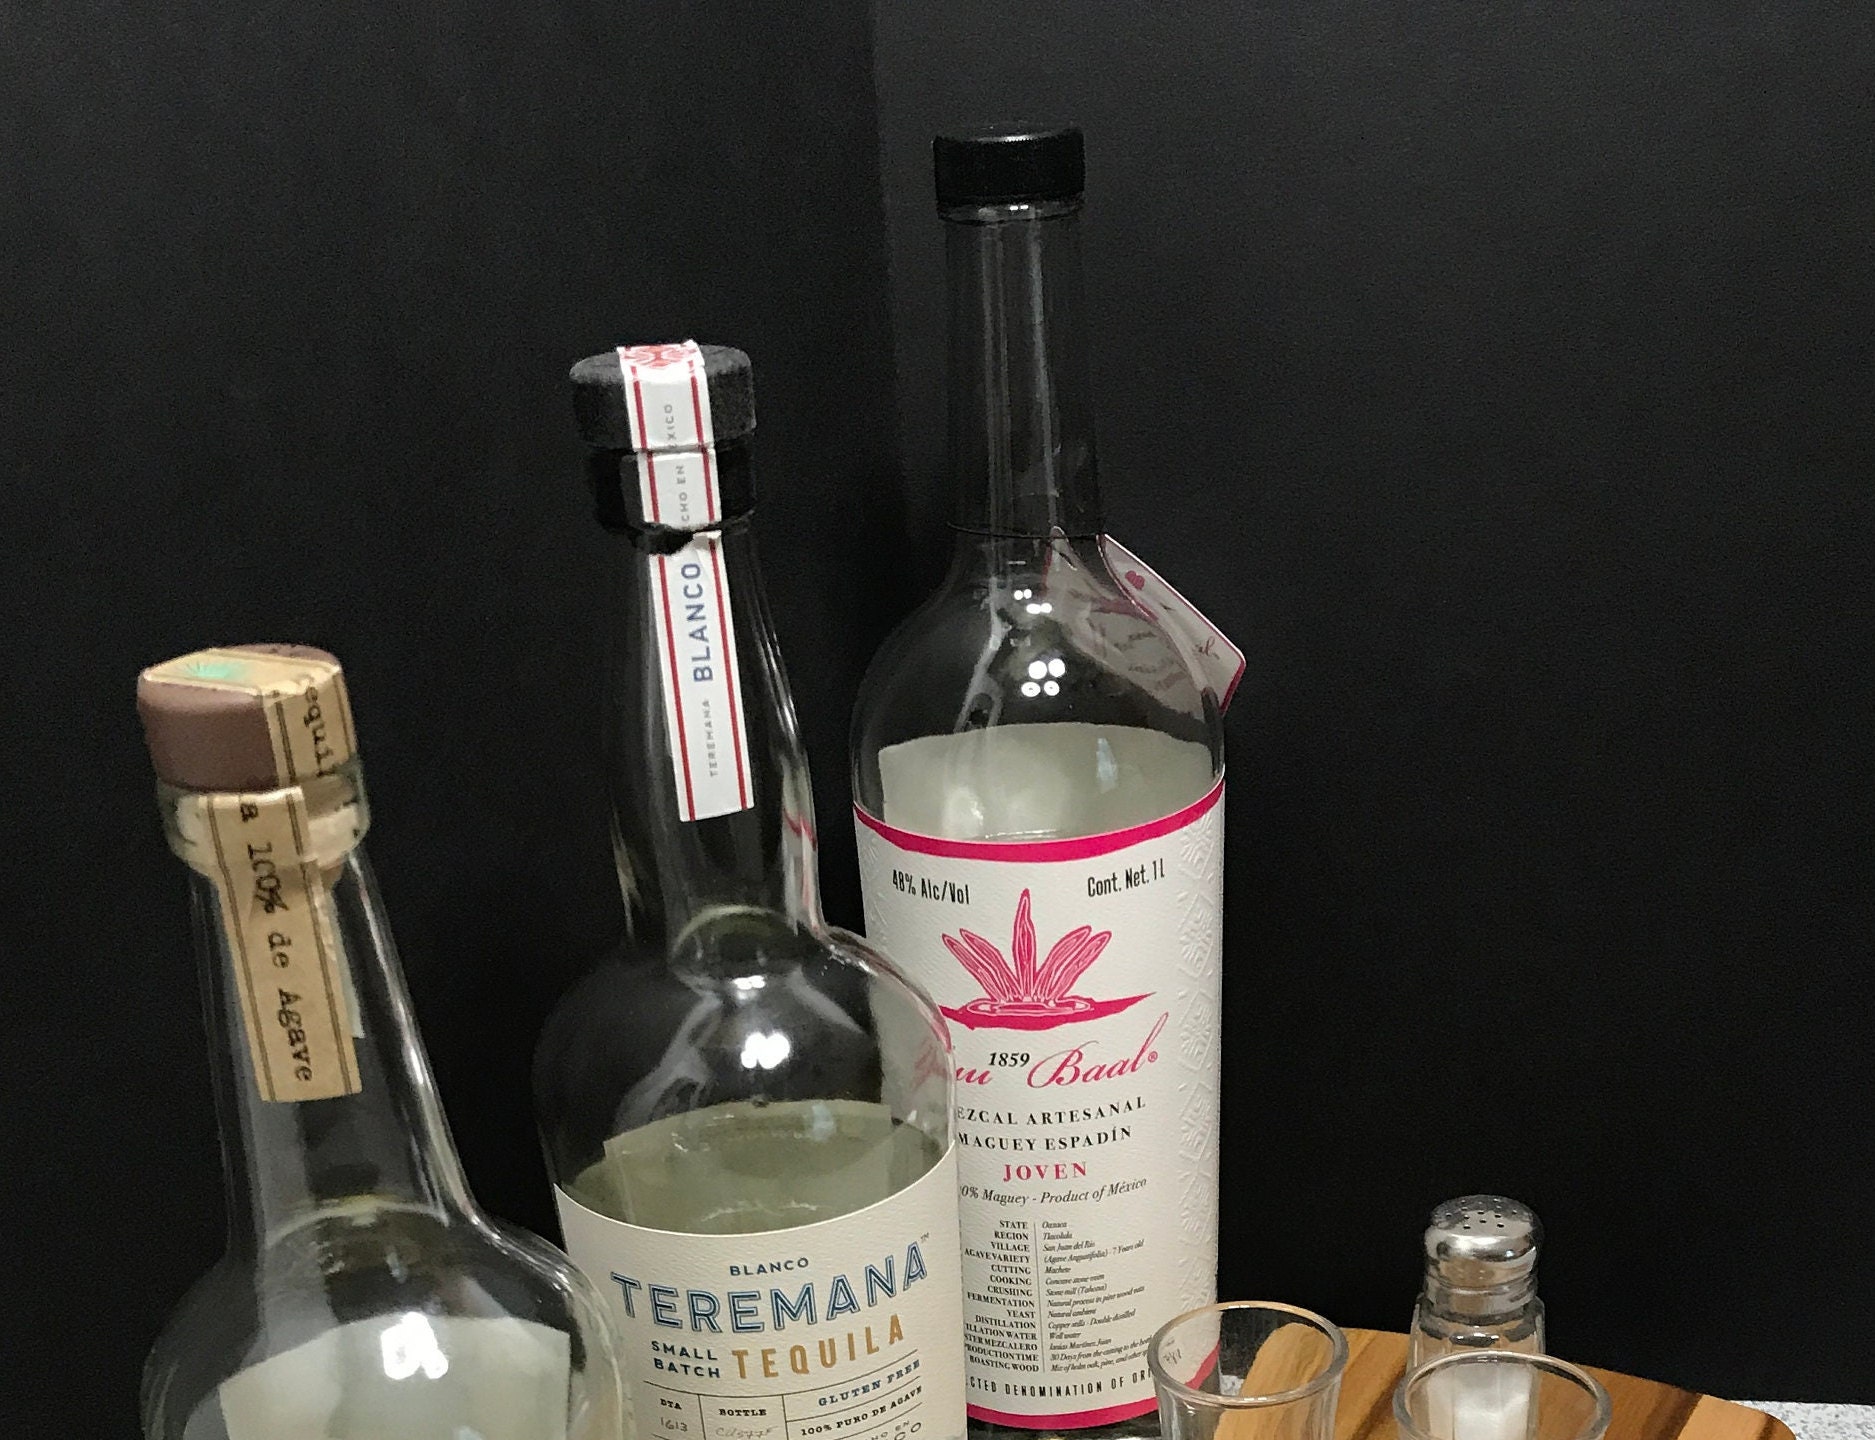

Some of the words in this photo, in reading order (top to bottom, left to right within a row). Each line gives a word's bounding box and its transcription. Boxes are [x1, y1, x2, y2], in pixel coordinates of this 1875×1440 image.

[675, 465, 686, 484] EN
[681, 563, 714, 683] BLANCO
[702, 700, 718, 778] TEREMANA
[246, 841, 289, 914] 100%
[892, 869, 917, 896] 48%
[921, 878, 970, 905] Alc/Vol
[1087, 872, 1122, 897] Cont.
[1125, 864, 1150, 889] Net.
[267, 931, 290, 970] de
[277, 988, 313, 1082] Agave
[988, 1052, 1031, 1068] 1859
[1026, 1012, 1169, 1089] Baal
[1026, 1096, 1146, 1126] ARTESANAL
[958, 1131, 1036, 1151] MAGUEY
[1045, 1126, 1132, 1151] ESPADÍN
[1003, 1161, 1087, 1183] JOVEN
[982, 1188, 1029, 1207] Maguey
[1040, 1189, 1090, 1204] Product
[1091, 1184, 1108, 1203] of
[1106, 1178, 1147, 1197] México
[994, 1230, 1029, 1241] REGION
[1000, 1220, 1028, 1230] STATE
[964, 1248, 992, 1260] AGAVE
[992, 1252, 1031, 1263] VARIETY
[1134, 1238, 1145, 1248] old
[990, 1241, 1030, 1253] VILLAGE
[1042, 1243, 1055, 1252] San
[1073, 1241, 1084, 1251] del
[730, 1257, 810, 1277] BLANCO
[991, 1264, 1032, 1275] CUTTING
[610, 1241, 928, 1334] TEREMANA
[987, 1285, 1033, 1297] CRUSHING
[1064, 1286, 1078, 1295] mill
[989, 1274, 1032, 1286] COOKING
[967, 1291, 1035, 1308] FERMENTATION
[1047, 1298, 1073, 1308] Natural
[975, 1314, 1036, 1329] DISTILLATION
[1048, 1321, 1071, 1331] Copper
[1006, 1309, 1036, 1319] YEAST
[1048, 1309, 1073, 1318] Natural
[731, 1314, 905, 1380] TEQUILA
[984, 1337, 1038, 1351] MEZCALERO
[1005, 1331, 1037, 1341] WATER
[651, 1340, 718, 1361] SMALL
[1015, 1352, 1039, 1362] TIME
[1077, 1351, 1092, 1361] from
[1092, 1349, 1103, 1357] the
[1130, 1341, 1140, 1349] the
[653, 1358, 721, 1380] BATCH
[969, 1354, 1011, 1370] ROASTING
[1011, 1362, 1040, 1372] WOOD
[818, 1380, 882, 1407] GLUTEN
[886, 1359, 921, 1384] FREE
[966, 1375, 997, 1393] CTED
[1004, 1381, 1102, 1397] DENOMINATION
[1111, 1376, 1124, 1390] OF
[718, 1408, 768, 1417] BOTTLE
[800, 1424, 833, 1437] 100%
[836, 1413, 869, 1429] PURO
[872, 1405, 887, 1418] DE
[890, 1385, 922, 1410] AGAVE
